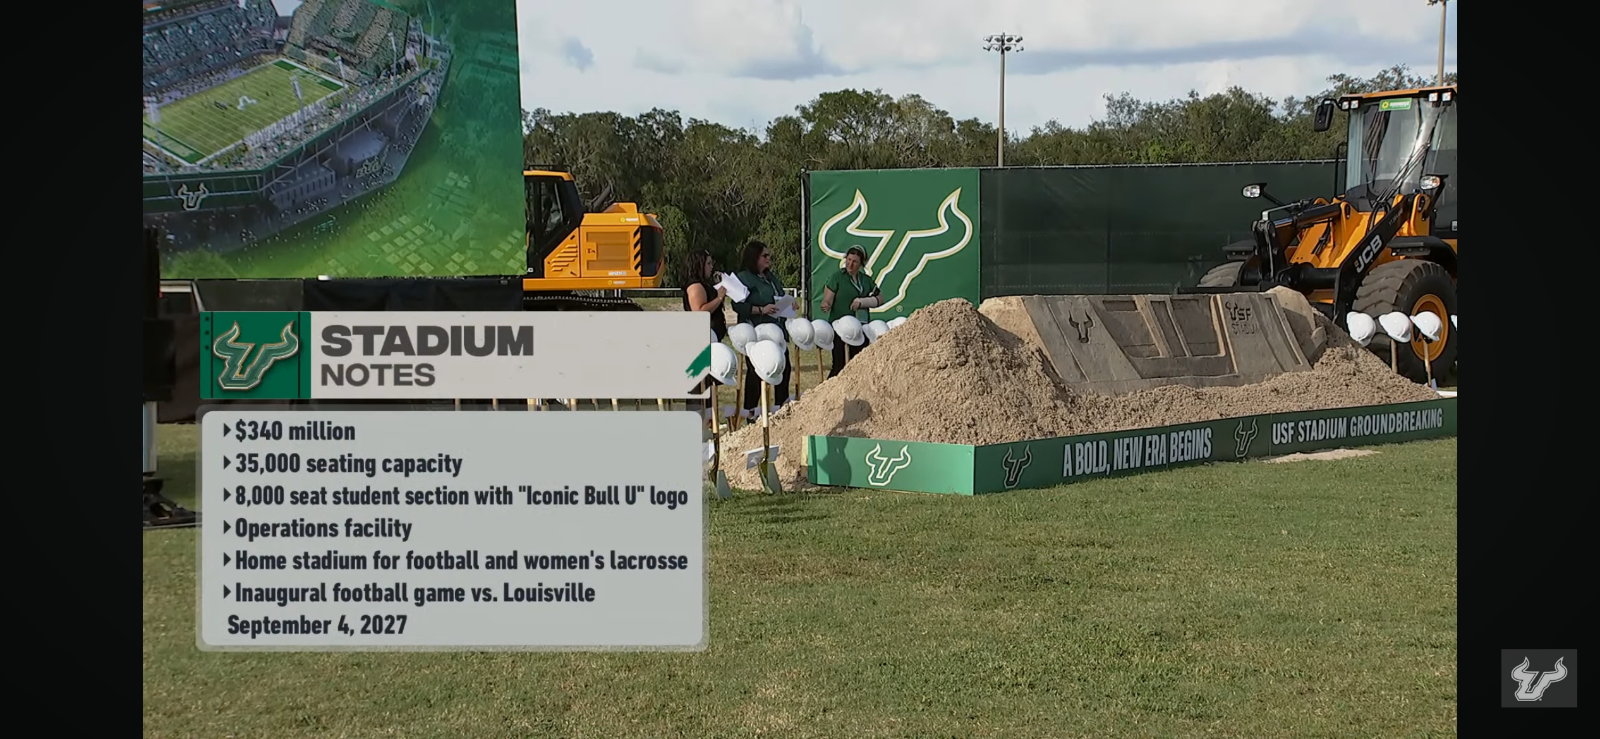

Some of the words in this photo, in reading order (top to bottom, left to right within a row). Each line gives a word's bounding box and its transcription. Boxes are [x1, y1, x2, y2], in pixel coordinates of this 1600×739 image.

[1356, 234, 1383, 273] JCB
[1225, 301, 1251, 321] USF
[1272, 421, 1295, 445] USF
[1298, 417, 1347, 443] STADIUM
[1350, 408, 1443, 437] GROUNDBREAKING
[1063, 443, 1073, 477] A
[1075, 440, 1110, 475] BOLD,
[1113, 436, 1143, 470] NEW
[1145, 433, 1167, 467] ERA
[1169, 427, 1212, 463] BEGINS
